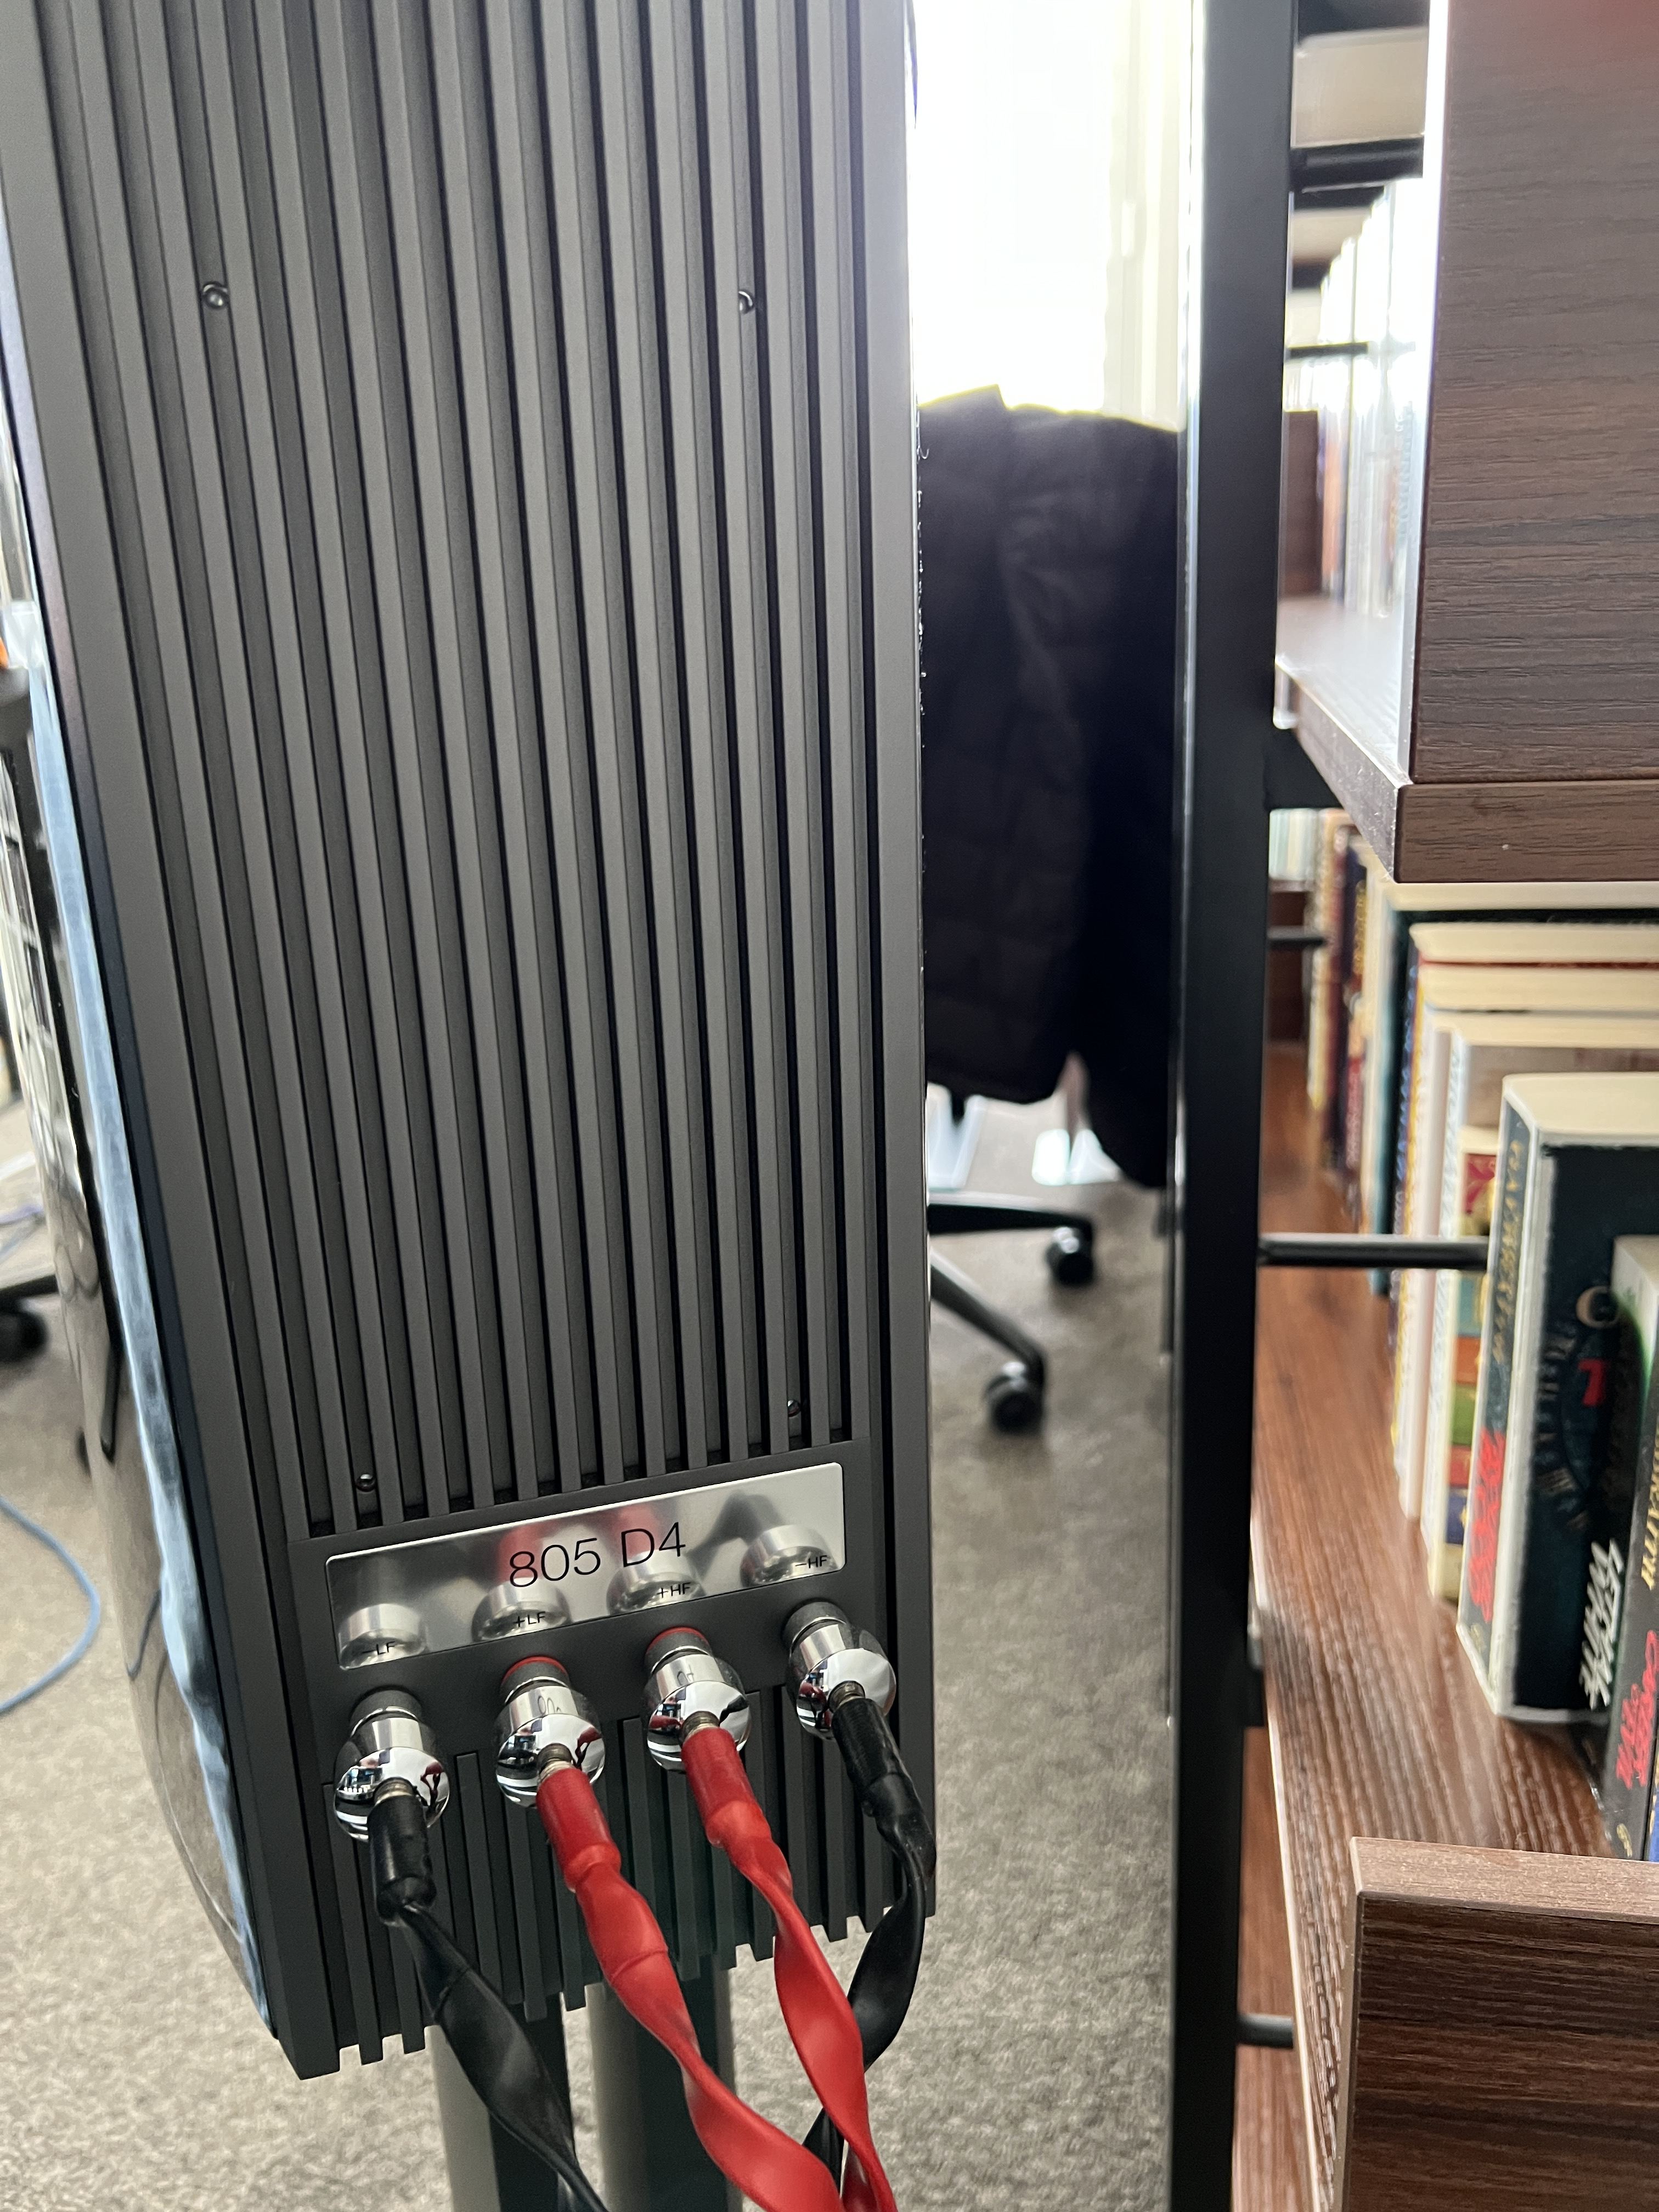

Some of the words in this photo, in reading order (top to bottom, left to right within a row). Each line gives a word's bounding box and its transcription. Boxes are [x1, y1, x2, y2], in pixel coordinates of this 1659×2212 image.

[509, 1537, 602, 1588] 805
[620, 1521, 686, 1568] D4
[657, 1581, 691, 1599] +HF
[512, 1611, 546, 1628] +LF
